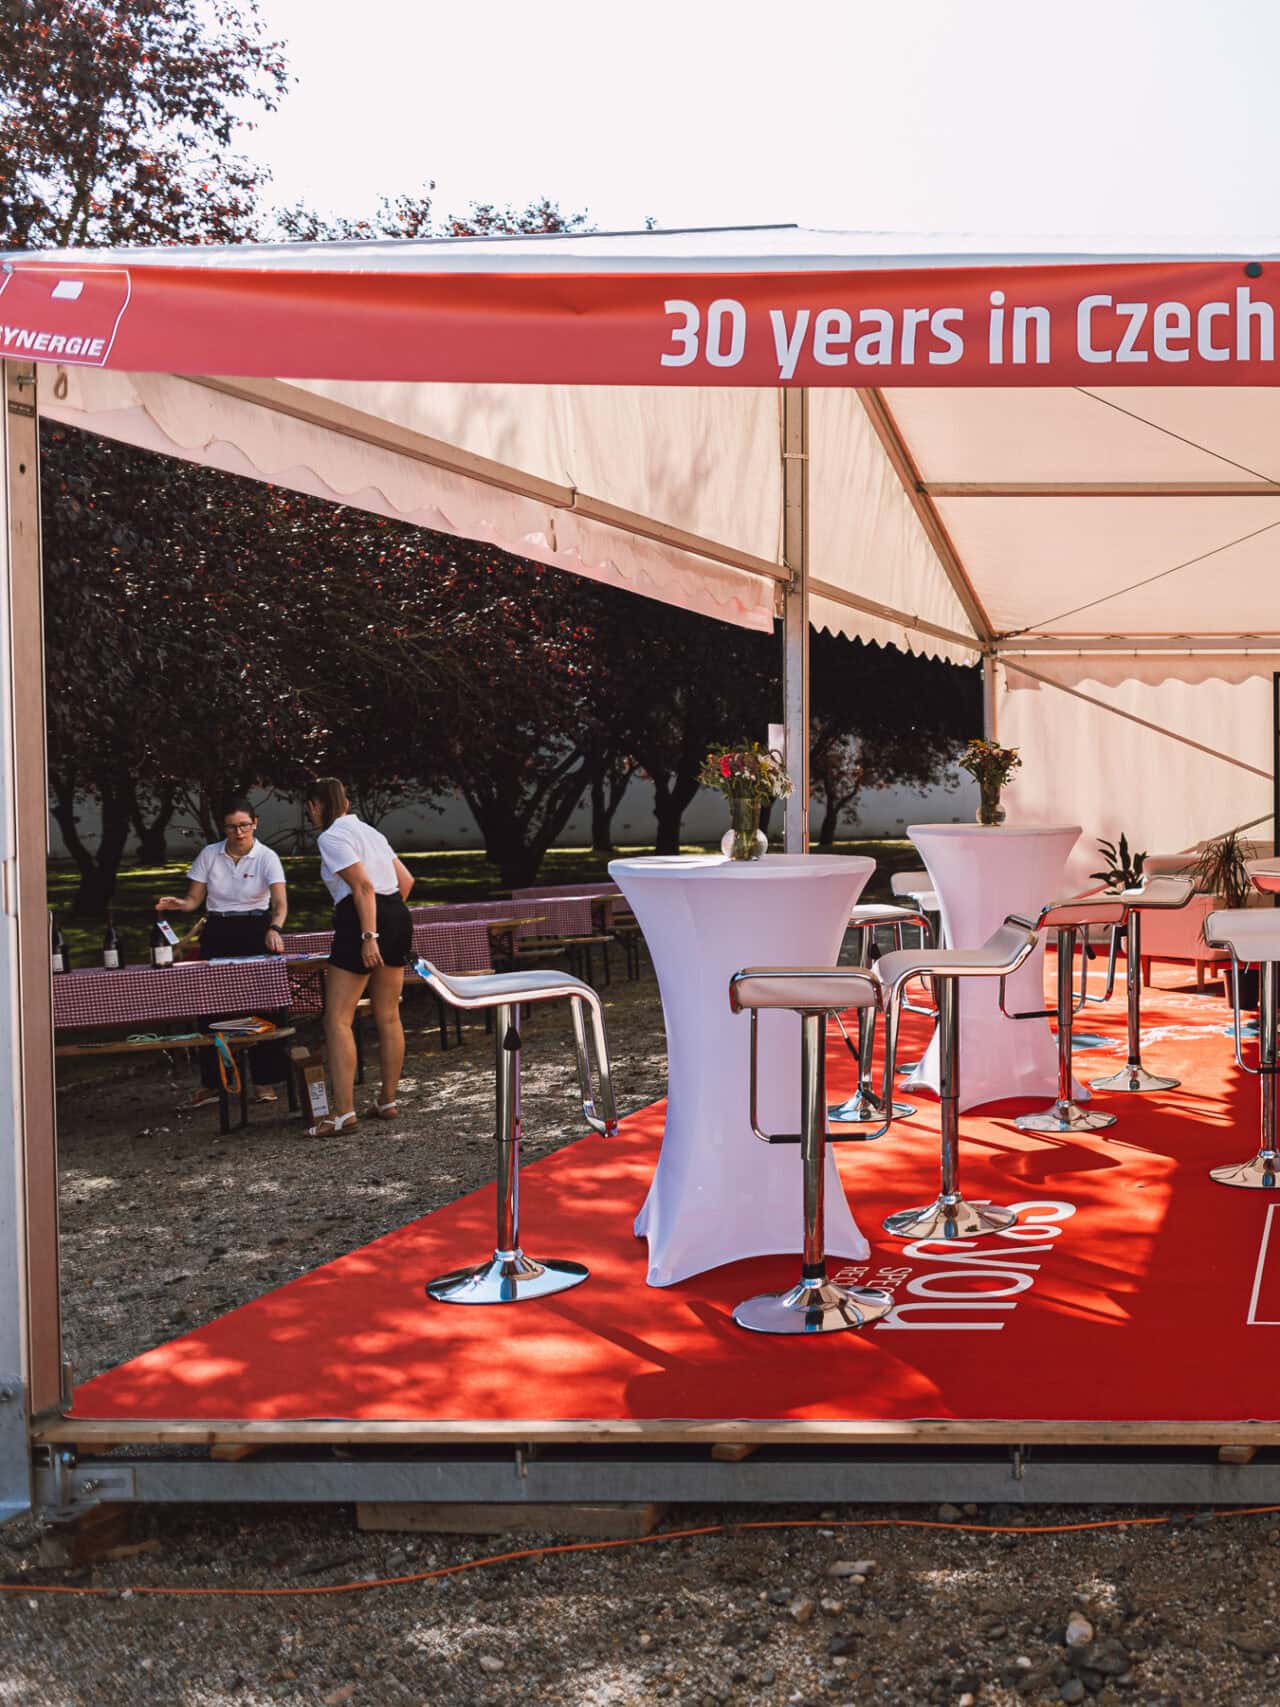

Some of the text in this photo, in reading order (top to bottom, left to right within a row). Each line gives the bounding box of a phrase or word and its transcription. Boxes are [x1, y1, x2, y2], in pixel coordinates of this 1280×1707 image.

[0, 325, 106, 357] YNERGIE
[660, 299, 746, 368] 30
[770, 306, 964, 380] years
[989, 290, 1051, 364] in
